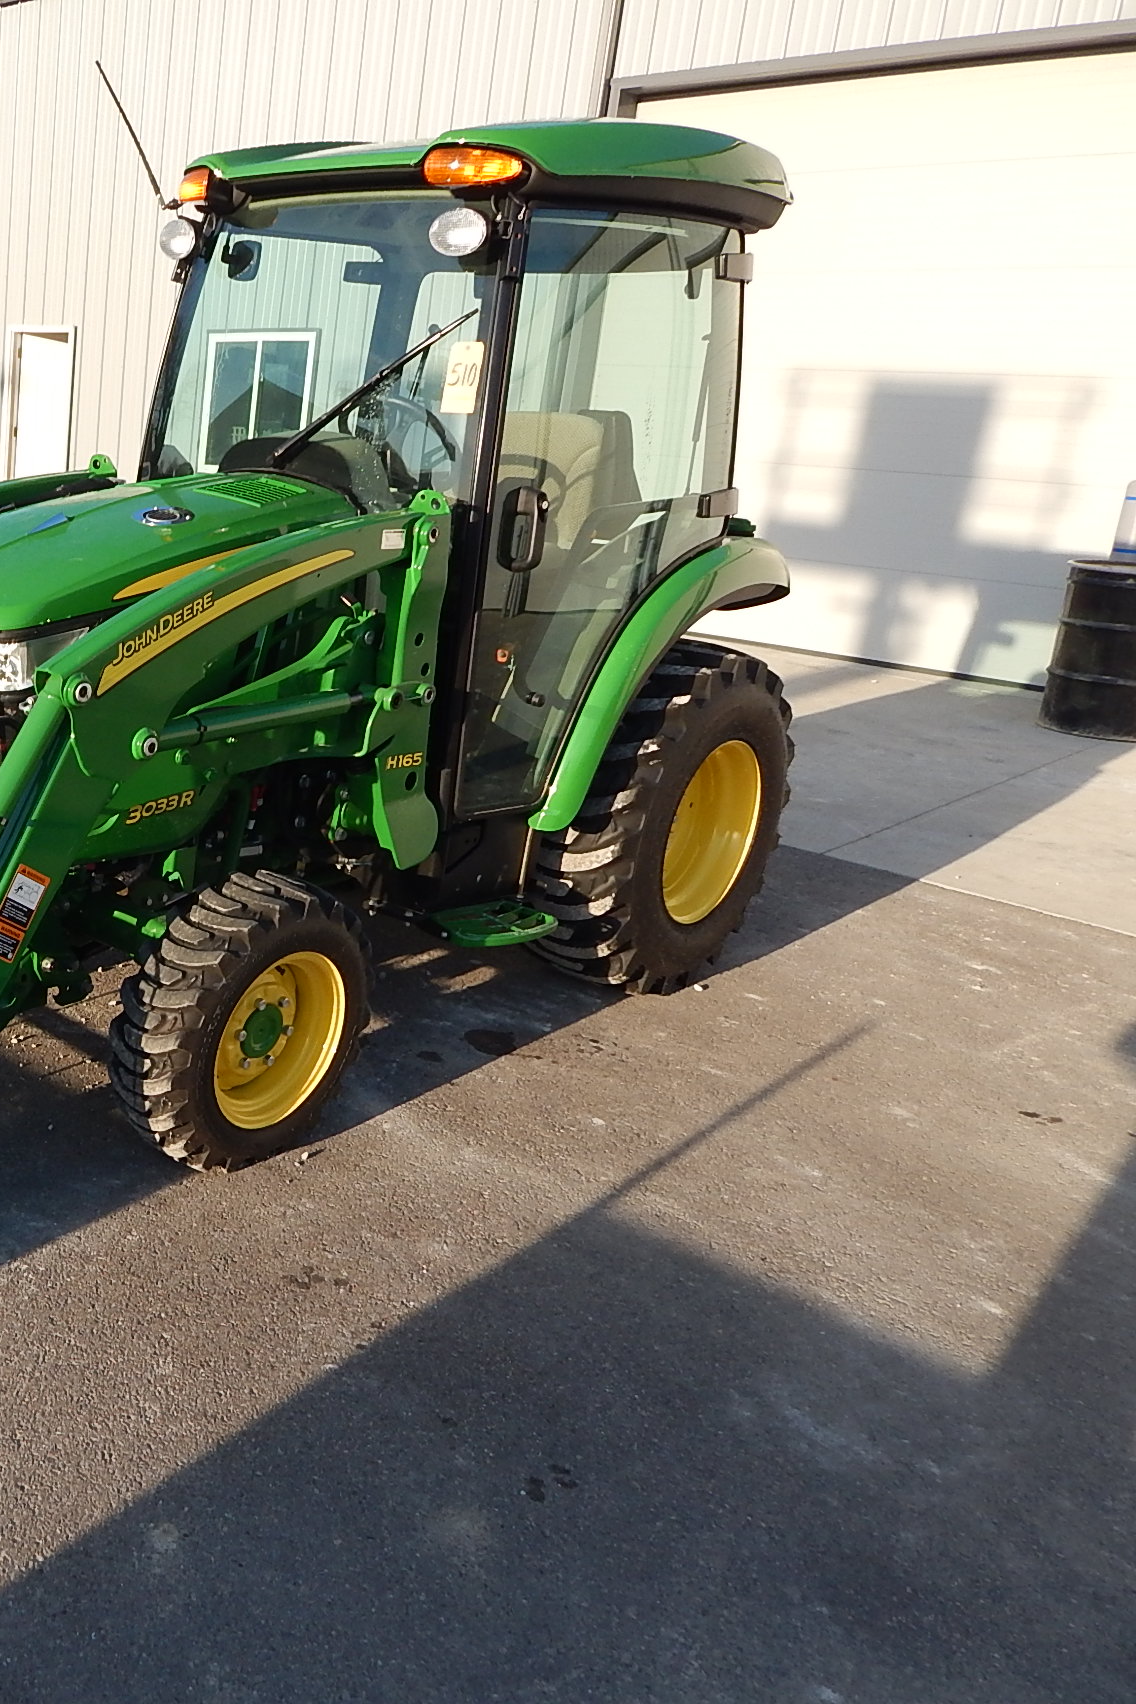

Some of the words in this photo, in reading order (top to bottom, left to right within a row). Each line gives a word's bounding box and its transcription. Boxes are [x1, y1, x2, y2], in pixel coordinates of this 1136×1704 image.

[447, 362, 478, 387] 510
[112, 624, 158, 666] JOHN
[158, 590, 214, 637] DEERE
[385, 751, 423, 770] H165
[125, 789, 195, 825] 3033R
